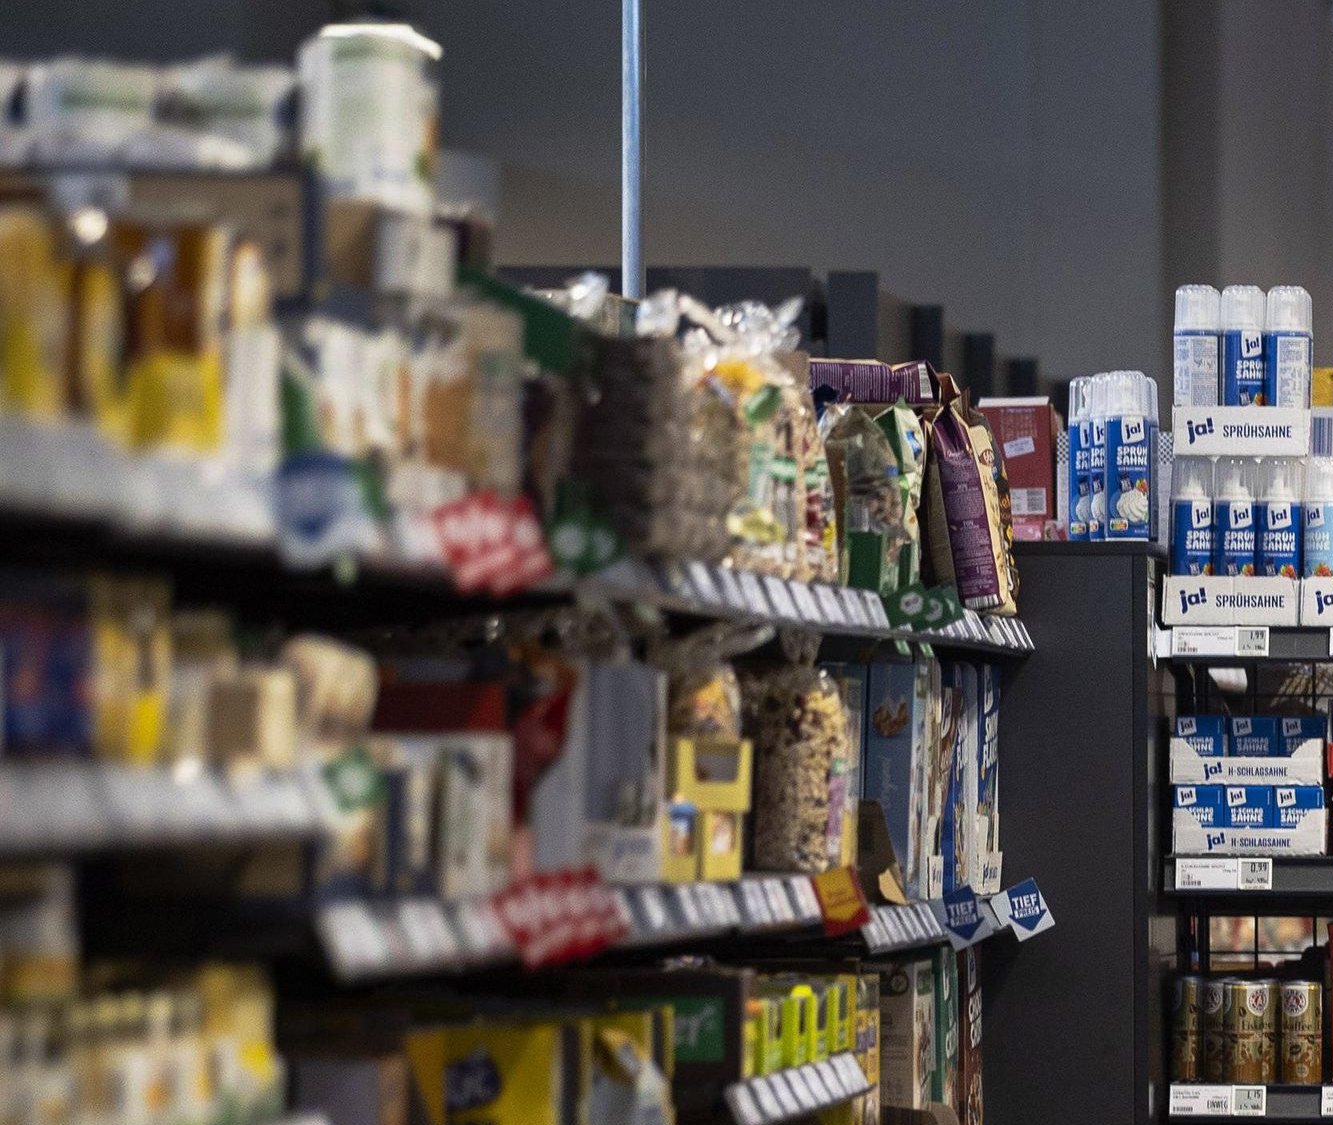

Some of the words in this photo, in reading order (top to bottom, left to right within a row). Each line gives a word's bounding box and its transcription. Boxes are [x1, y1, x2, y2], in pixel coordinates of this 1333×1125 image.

[1187, 417, 1214, 444] ja!
[1222, 423, 1292, 438] SPRÜHSAHNE
[1271, 508, 1287, 526] ja!
[1179, 587, 1207, 615] ja!
[1215, 593, 1285, 608] SPRÜHSAHNE
[1011, 893, 1038, 910] TIEF
